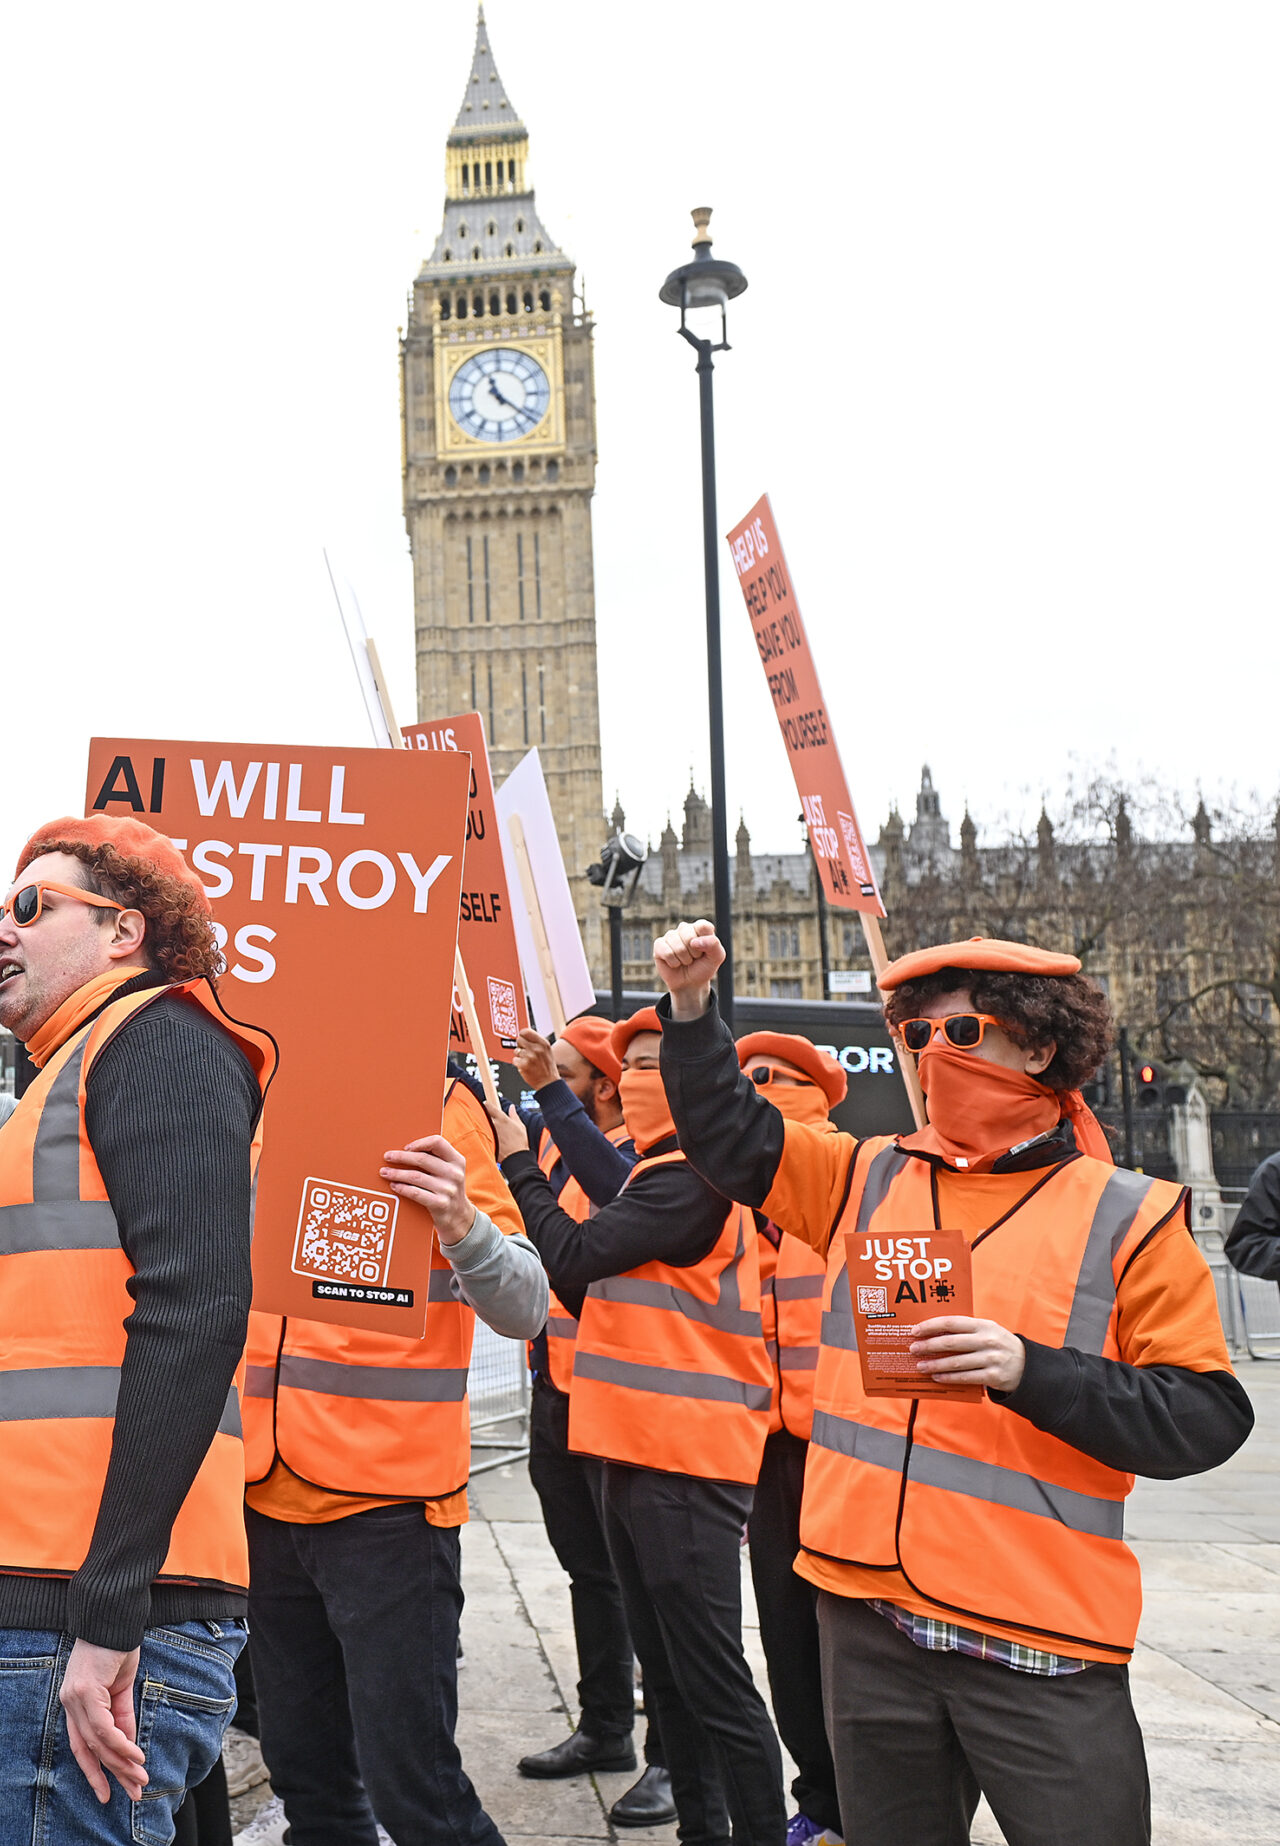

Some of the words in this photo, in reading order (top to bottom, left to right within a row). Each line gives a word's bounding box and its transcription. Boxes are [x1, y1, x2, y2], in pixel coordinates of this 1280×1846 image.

[731, 529, 756, 576] HELP
[750, 517, 769, 558] US
[744, 576, 768, 620] HELP
[764, 560, 787, 605] YOU
[756, 622, 784, 663] SAVE
[777, 610, 801, 652] YOU
[768, 667, 800, 707] FROM
[780, 709, 828, 751] YOURSELF
[92, 756, 166, 813] AI
[190, 758, 365, 825] WILL
[801, 795, 827, 826] JUST
[813, 827, 839, 859] STOP
[170, 838, 454, 914] STROY
[860, 1238, 931, 1260] JUST
[874, 1258, 952, 1281] STOP
[317, 1285, 348, 1297] SCAN
[349, 1289, 364, 1298] TO
[366, 1290, 395, 1301] STOP
[396, 1294, 409, 1303] AI
[895, 1280, 927, 1304] AI
